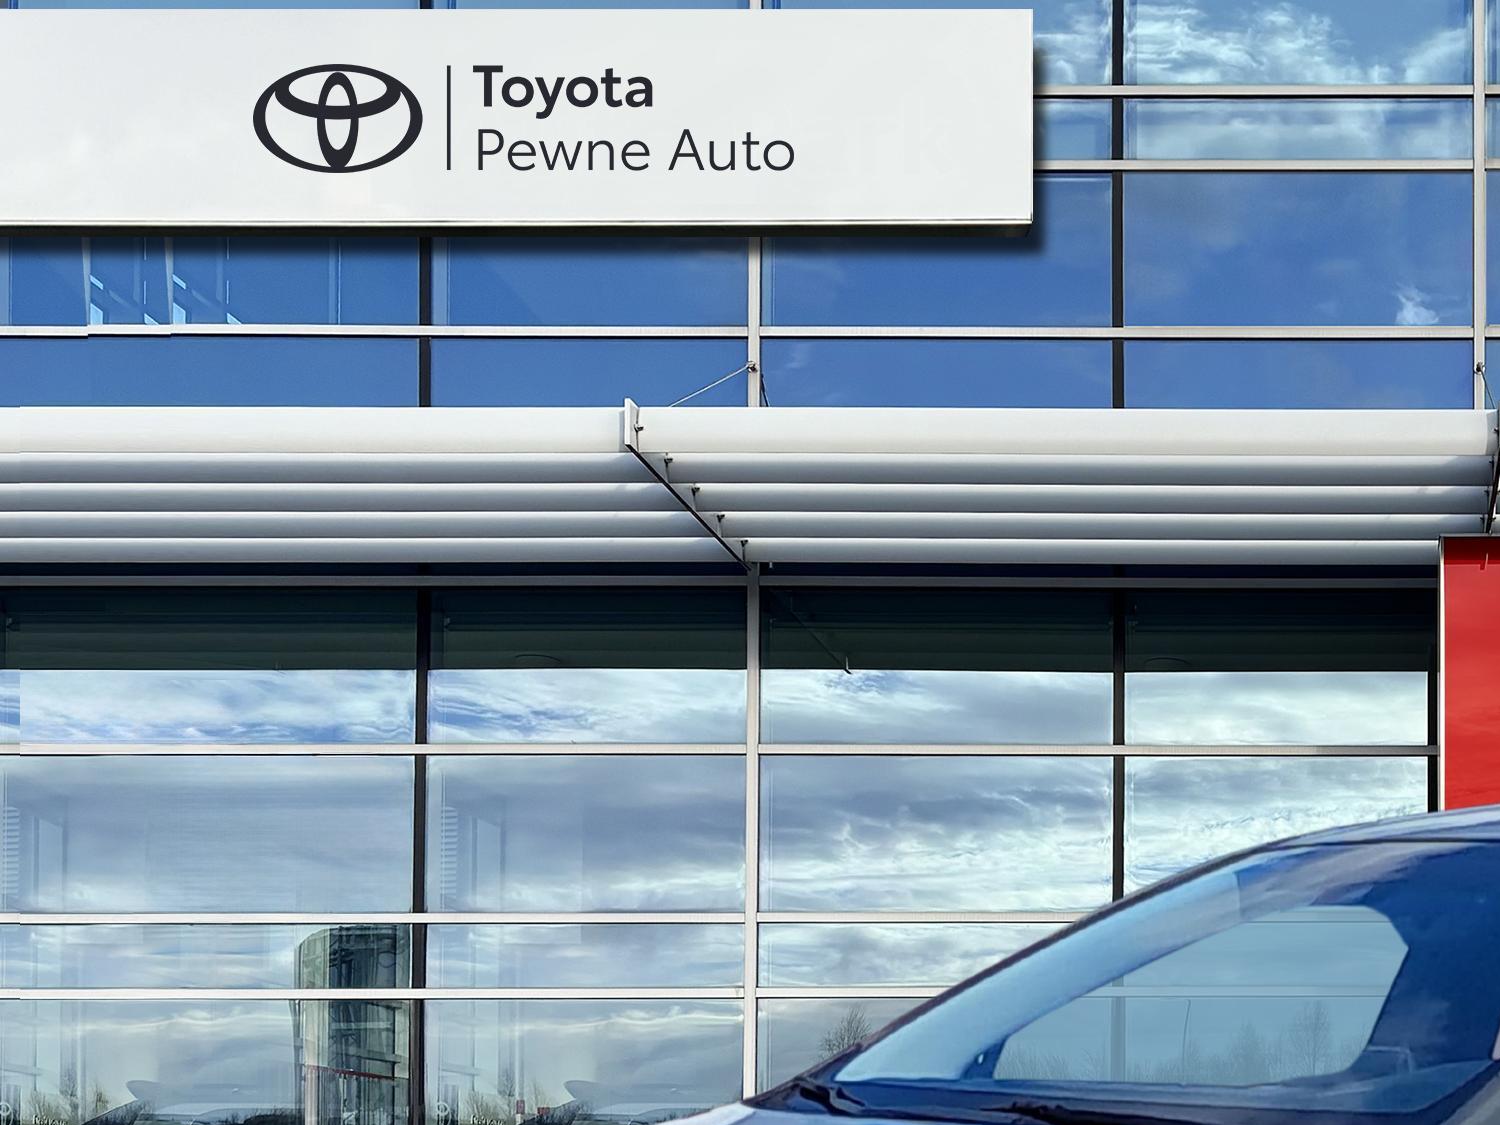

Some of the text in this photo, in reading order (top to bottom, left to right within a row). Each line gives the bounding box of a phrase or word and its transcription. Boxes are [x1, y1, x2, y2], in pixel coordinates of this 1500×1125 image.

[473, 64, 653, 119] Toyota
[477, 128, 796, 172] Pewne Auto
